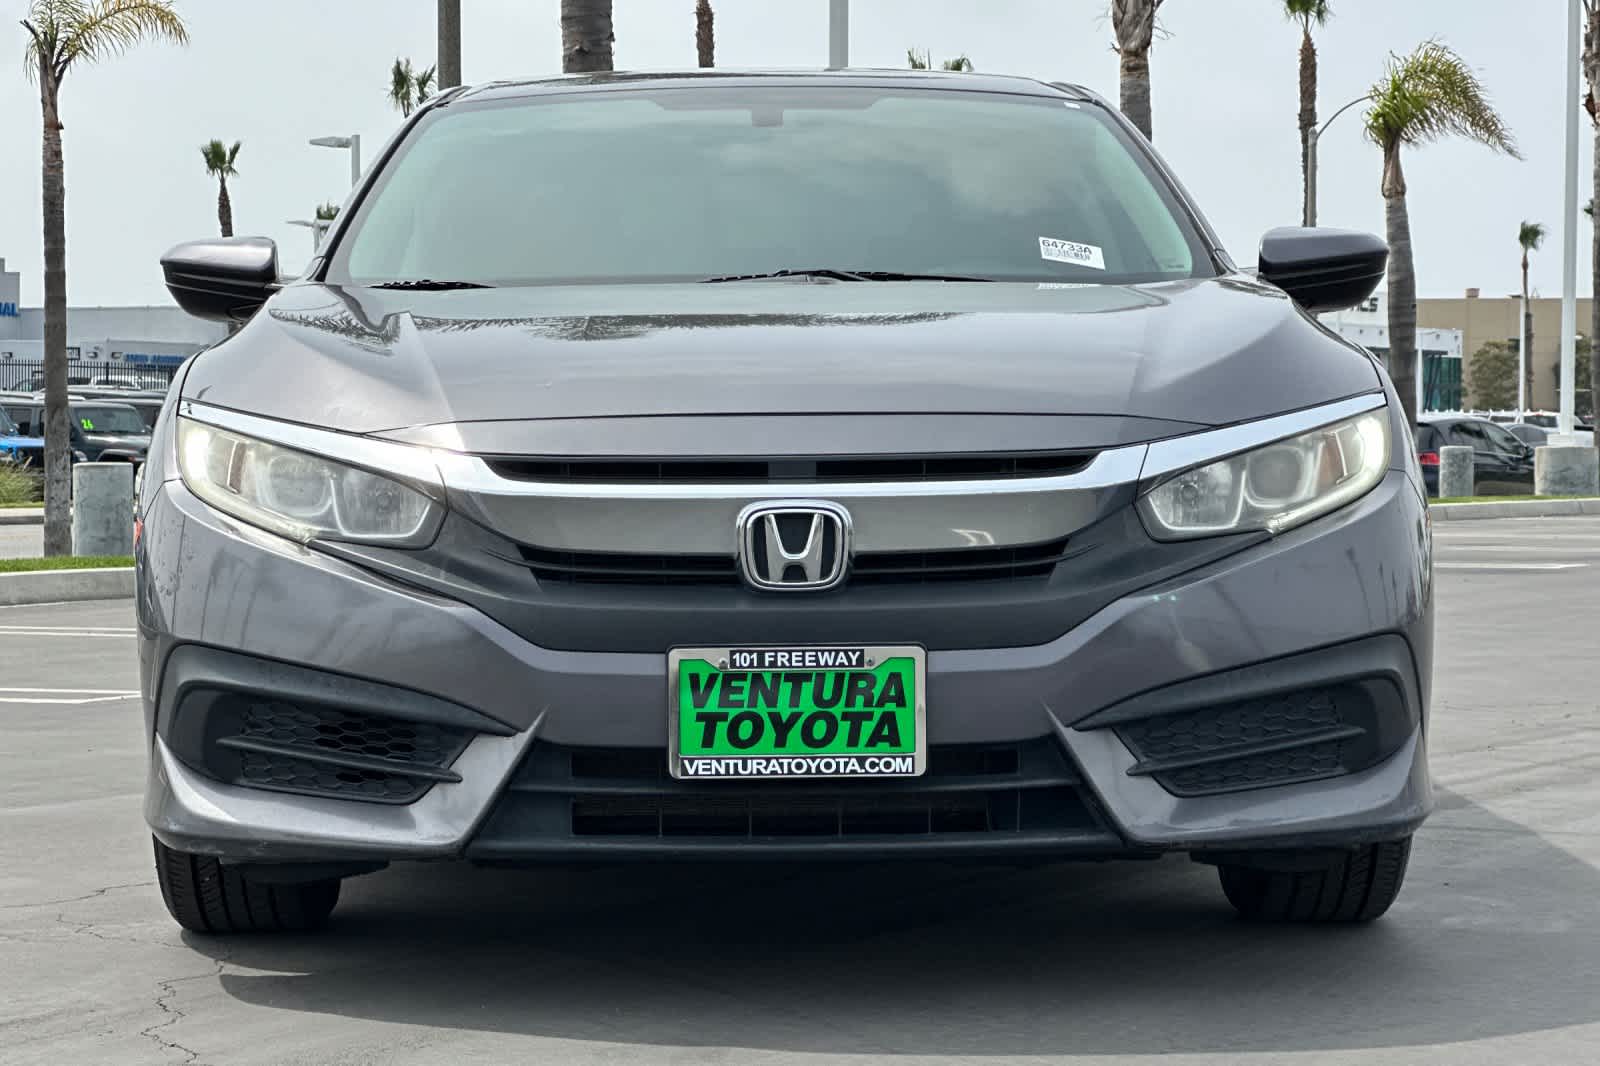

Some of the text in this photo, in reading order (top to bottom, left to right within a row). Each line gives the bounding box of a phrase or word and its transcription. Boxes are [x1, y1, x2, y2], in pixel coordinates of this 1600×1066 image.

[1041, 239, 1092, 255] 64733A
[732, 651, 860, 667] 101 FREEWAY
[688, 672, 907, 709] VENTURA
[695, 710, 902, 749] TOYOTA
[683, 757, 913, 775] VENTURATOYOTA.COM
